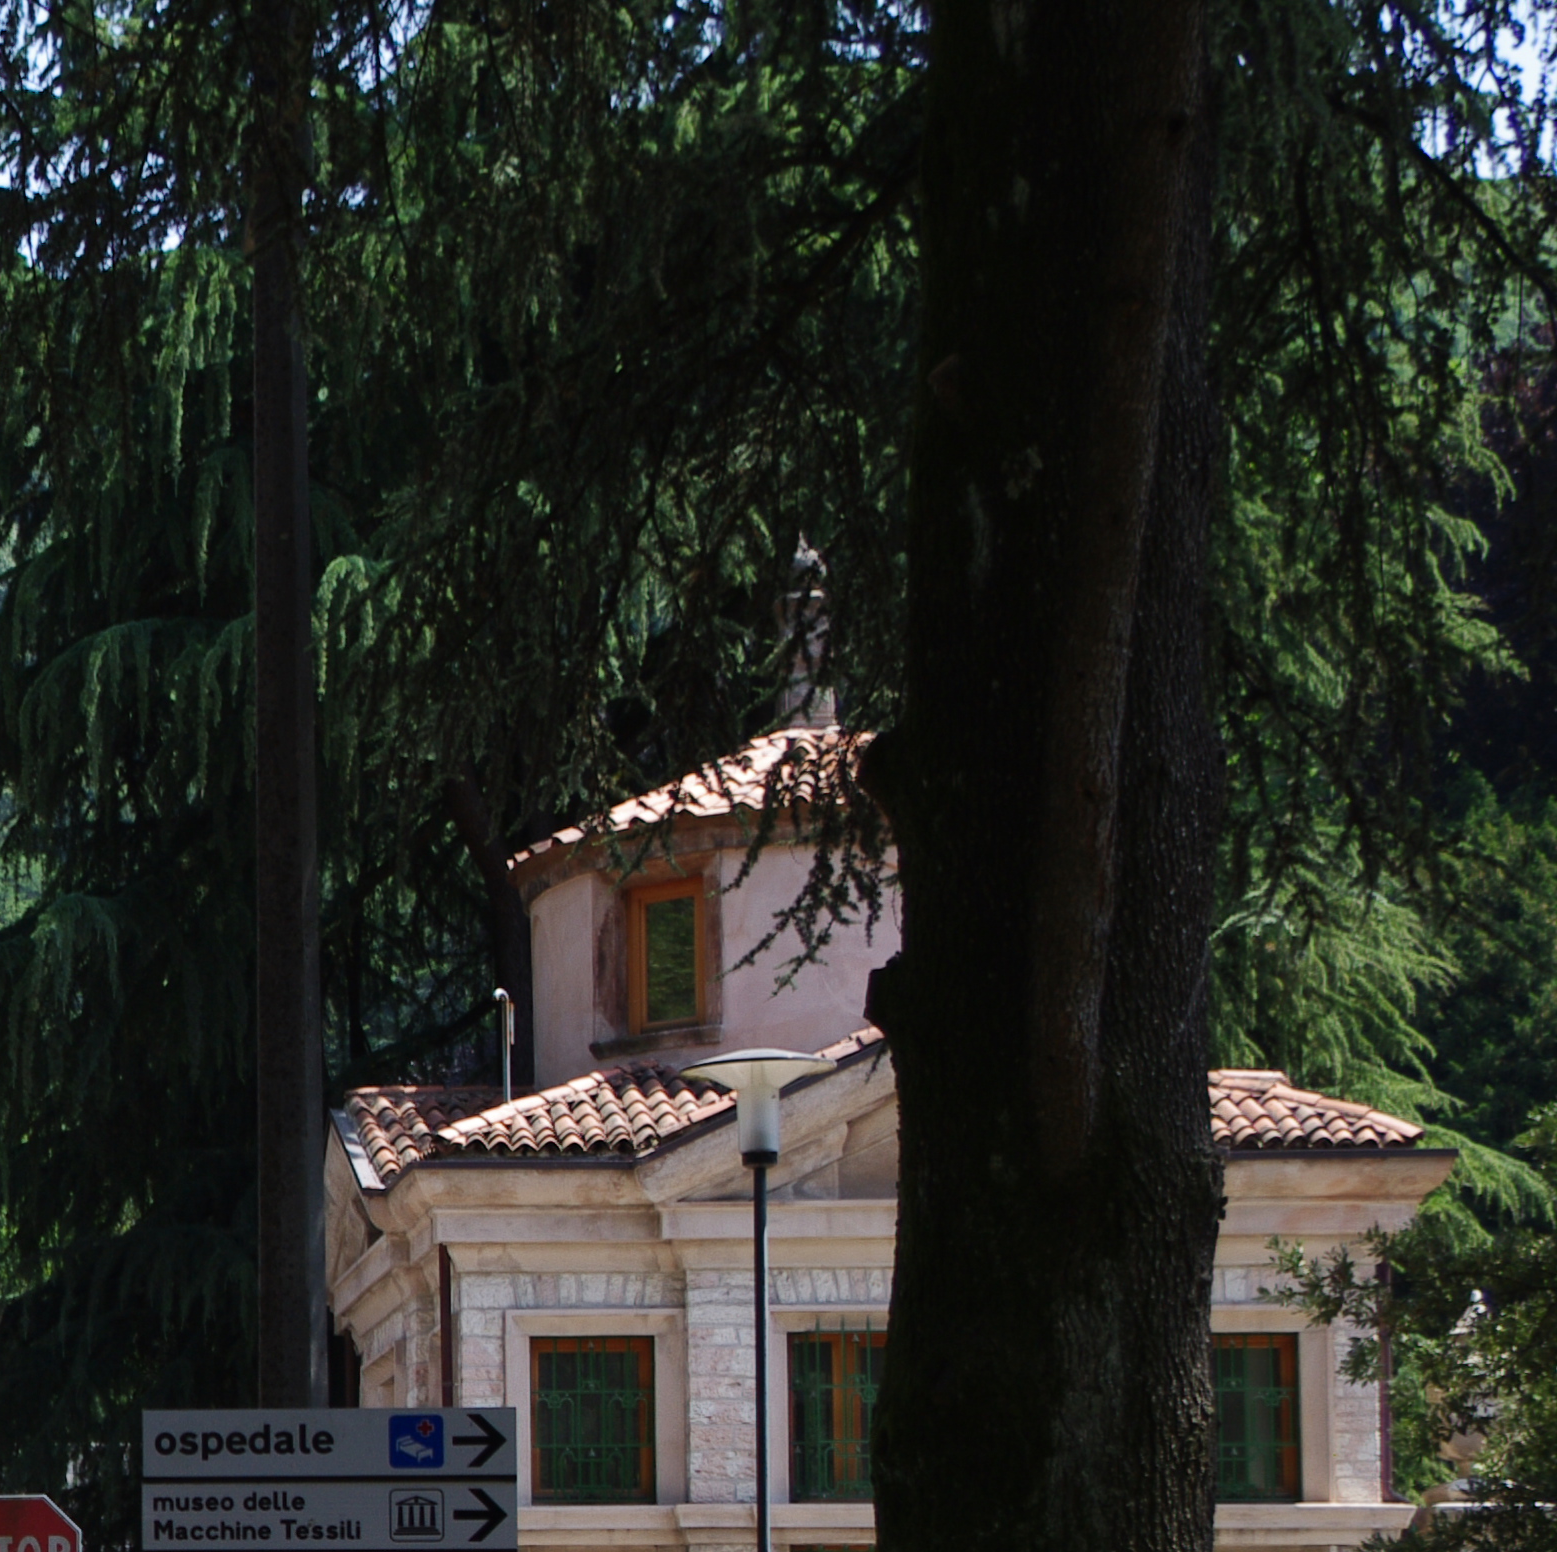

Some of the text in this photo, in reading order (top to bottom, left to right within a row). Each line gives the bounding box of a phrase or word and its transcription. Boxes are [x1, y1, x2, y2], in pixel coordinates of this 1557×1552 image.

[154, 1423, 335, 1462] ospedale
[152, 1491, 306, 1512] museo delle
[153, 1519, 362, 1541] Macchine Tessili
